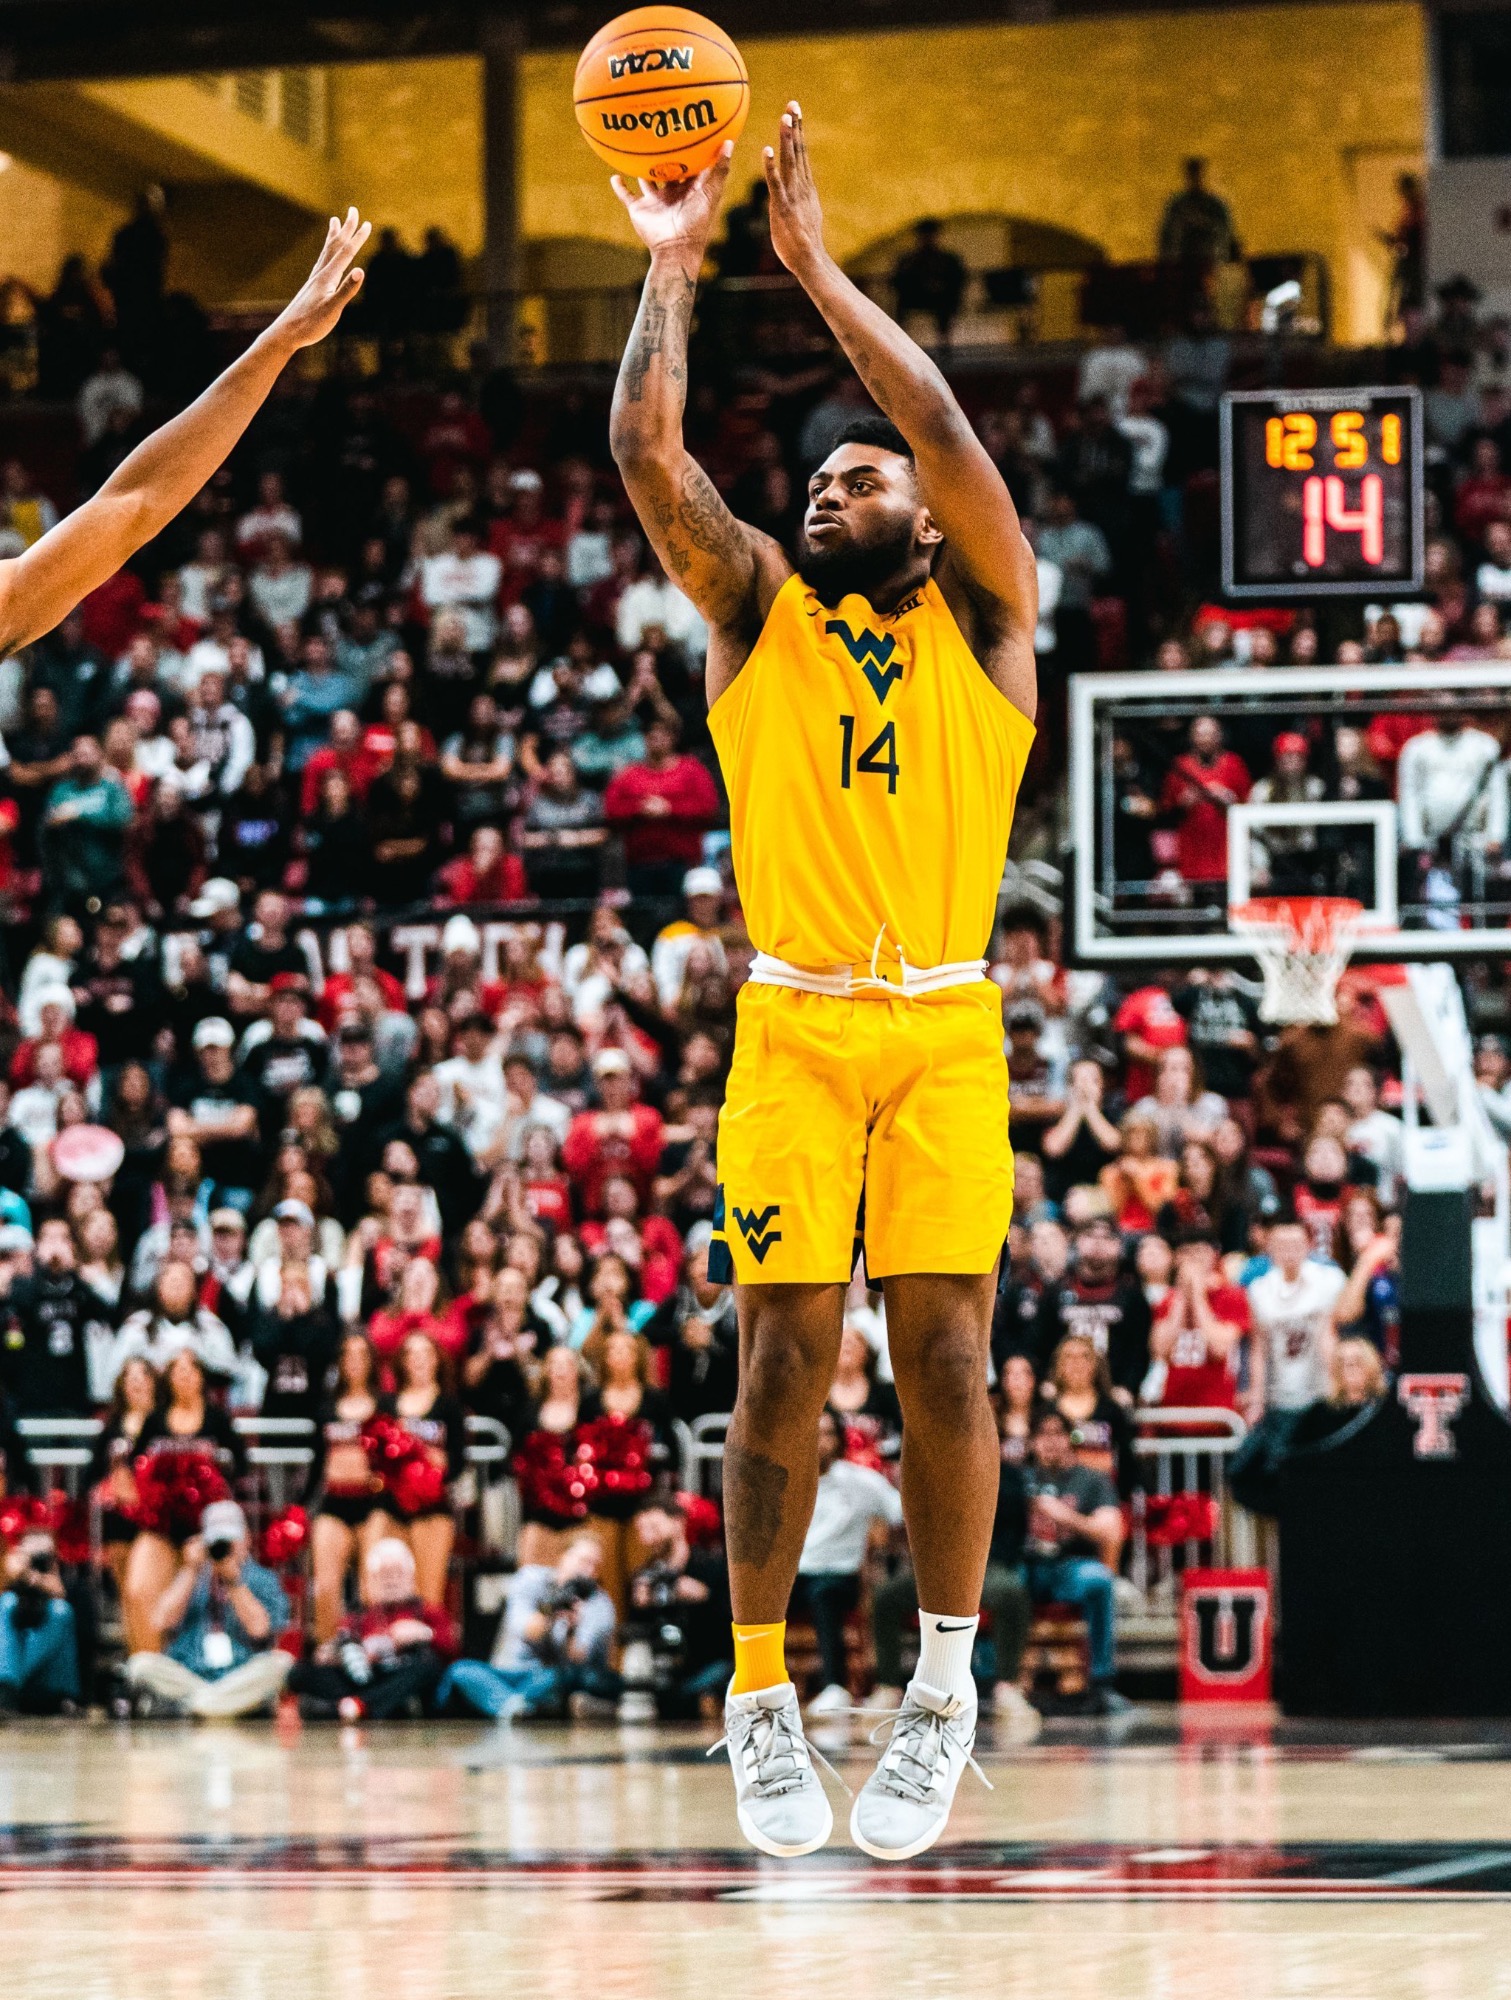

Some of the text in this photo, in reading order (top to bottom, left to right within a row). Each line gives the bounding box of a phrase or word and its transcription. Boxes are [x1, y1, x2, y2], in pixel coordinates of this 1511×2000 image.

[609, 47, 694, 80] NCAA
[601, 100, 718, 138] Wilson
[1303, 473, 1384, 567] 14
[839, 714, 900, 795] 14
[1188, 1589, 1265, 1684] U
